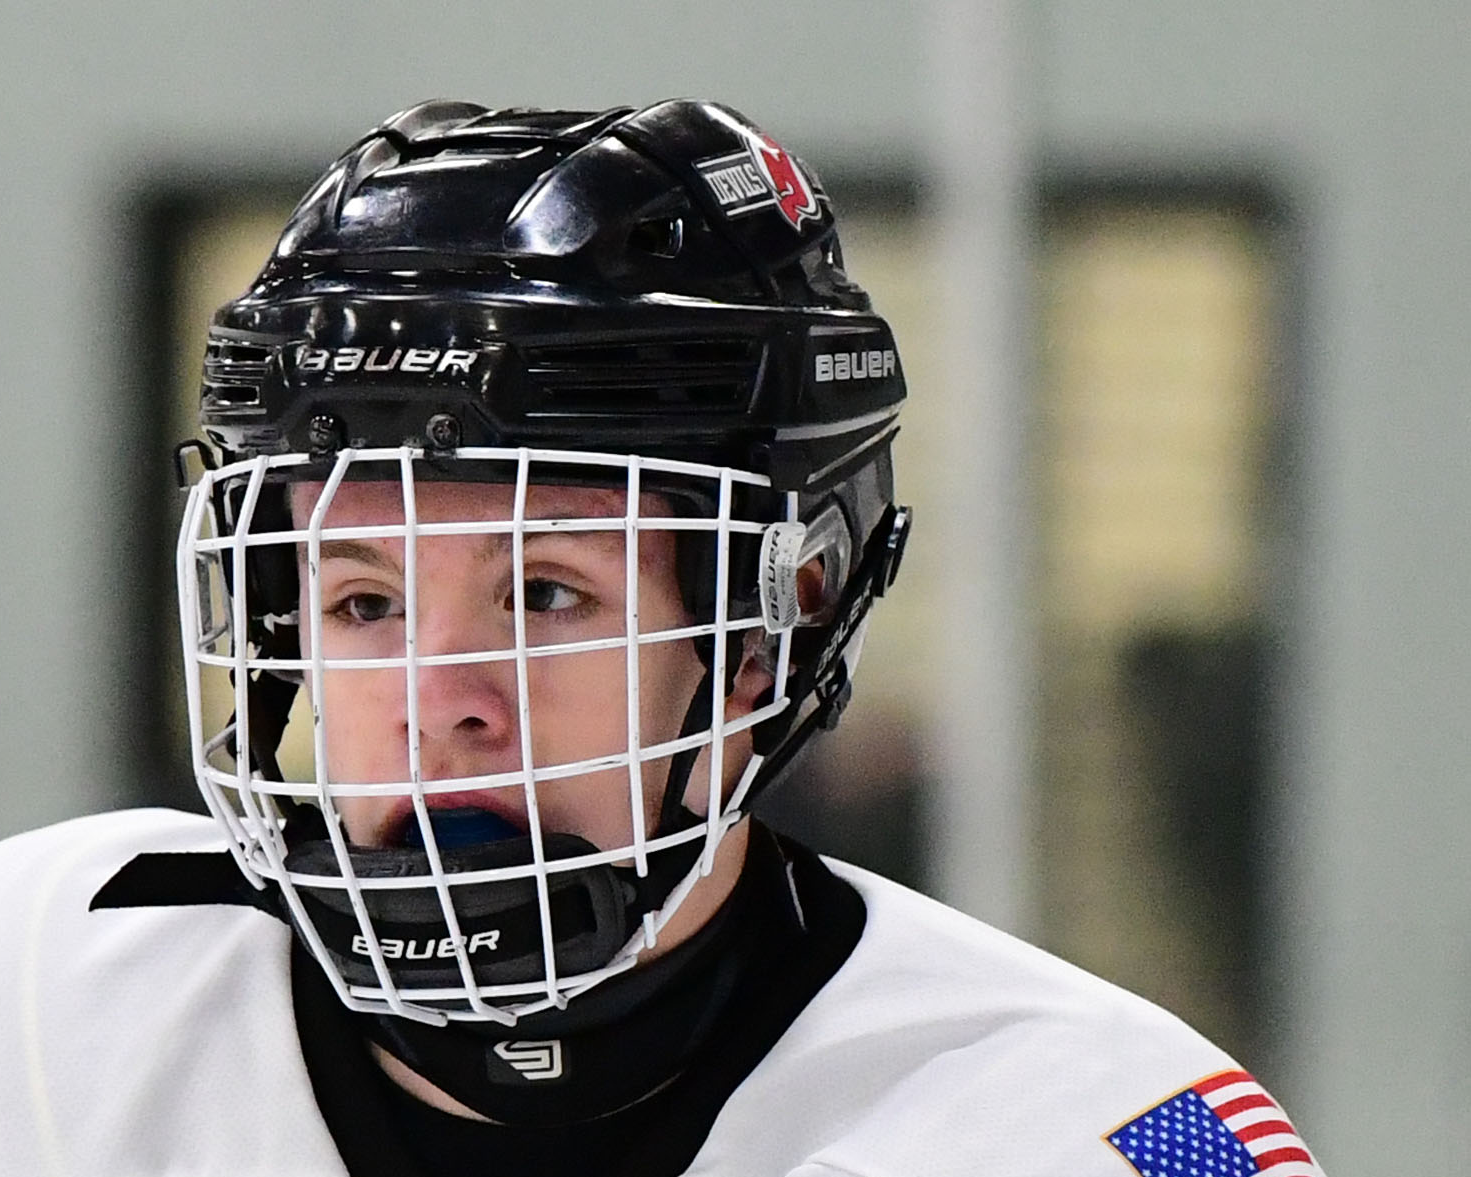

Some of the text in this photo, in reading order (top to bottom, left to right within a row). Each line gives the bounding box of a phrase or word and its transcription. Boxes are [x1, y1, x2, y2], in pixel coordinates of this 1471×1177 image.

[704, 162, 768, 206] DEVILS
[296, 347, 478, 373] BAUER
[815, 349, 895, 382] BAUER
[352, 929, 500, 960] BAUER
